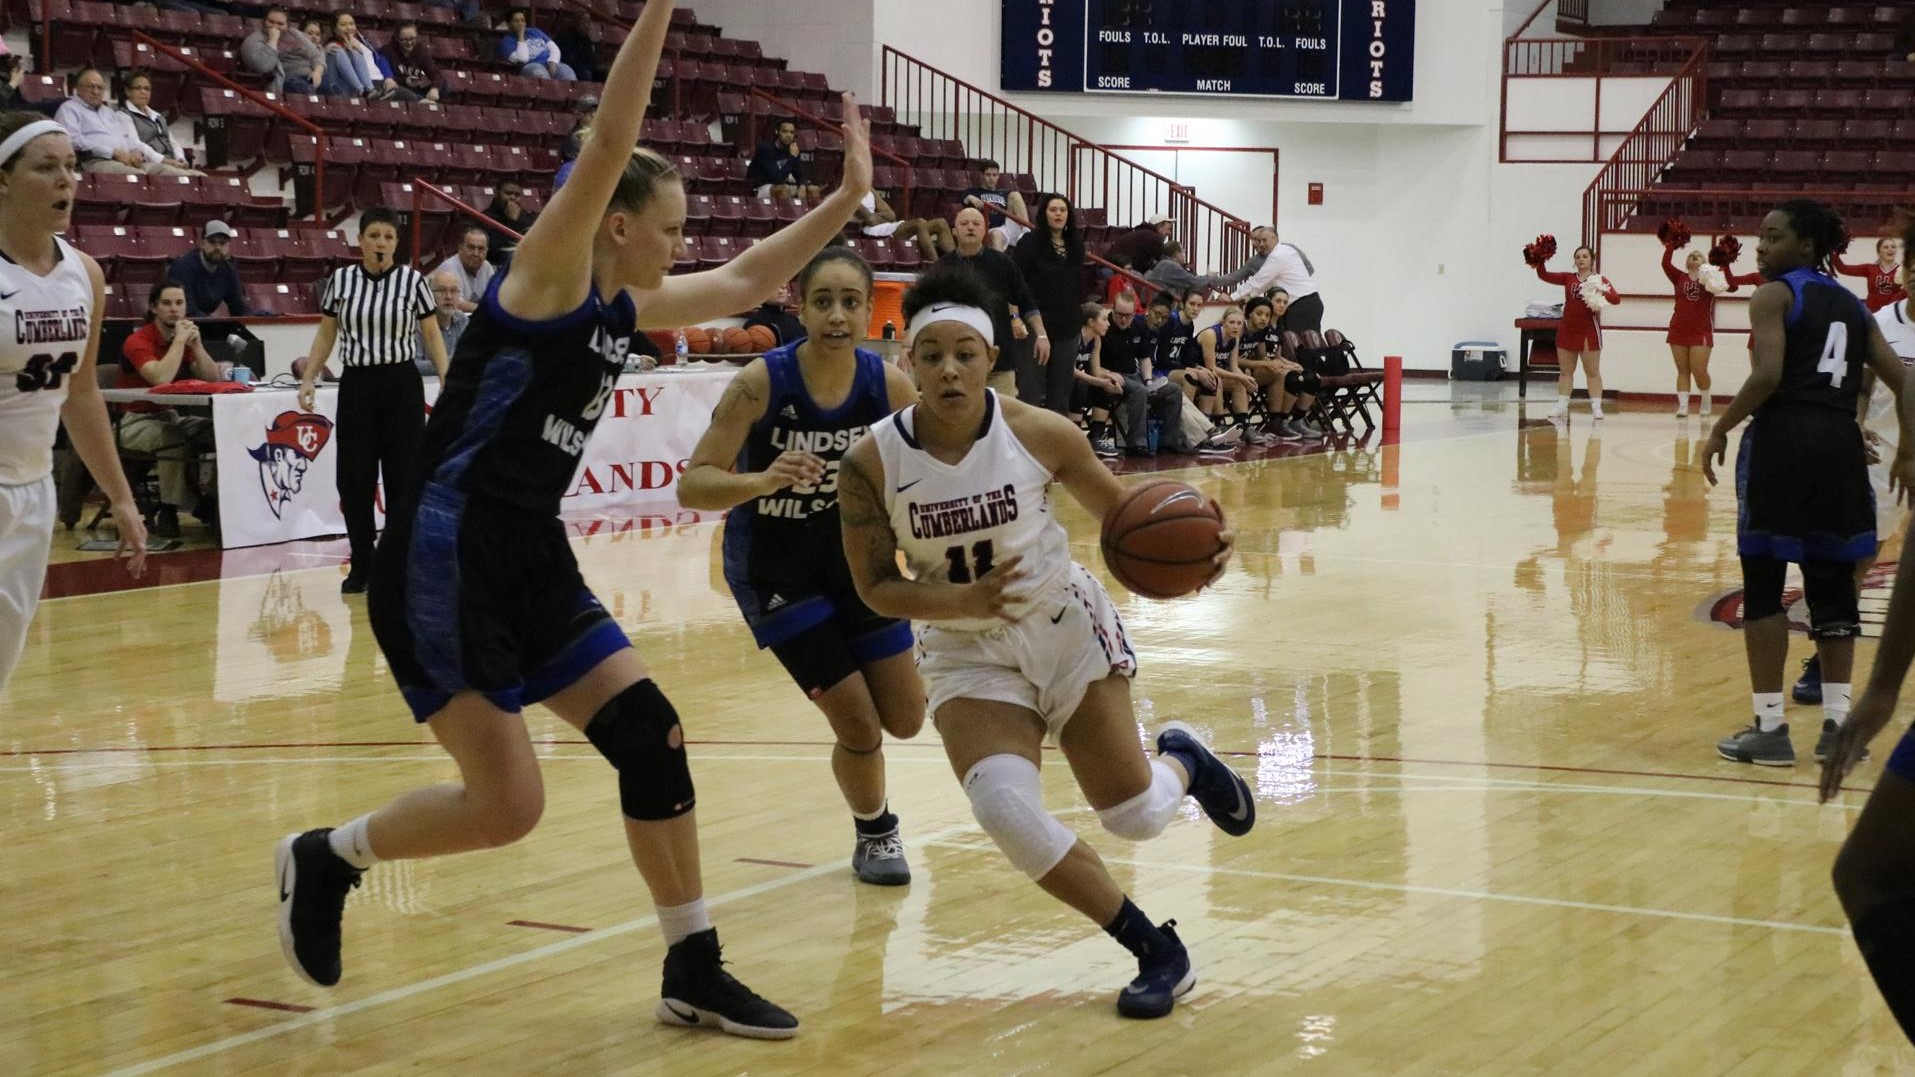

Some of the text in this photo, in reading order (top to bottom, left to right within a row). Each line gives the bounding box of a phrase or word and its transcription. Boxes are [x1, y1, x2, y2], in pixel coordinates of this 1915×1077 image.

[1037, 0, 1054, 87] IOTS
[1099, 31, 1131, 43] FOULS
[1143, 32, 1171, 44] T.O.L.
[1182, 33, 1248, 47] PLAYER FOUL
[1258, 36, 1285, 48] T.O.L.
[1295, 37, 1327, 50] FOULS
[1369, 1, 1386, 97] RIOTS
[1098, 76, 1131, 88] SCORE
[1197, 79, 1231, 91] MATCH
[1294, 83, 1326, 94] SCORE
[1170, 124, 1188, 138] EXIT
[1816, 321, 1848, 389] 4
[296, 425, 318, 453] UC
[541, 413, 592, 457] WILS
[791, 460, 841, 495] 3
[758, 497, 839, 519] WILS
[908, 483, 1018, 540] CUMBERLANDS
[919, 489, 1002, 514] UNIVERSITY OF THE
[945, 539, 995, 584] 11
